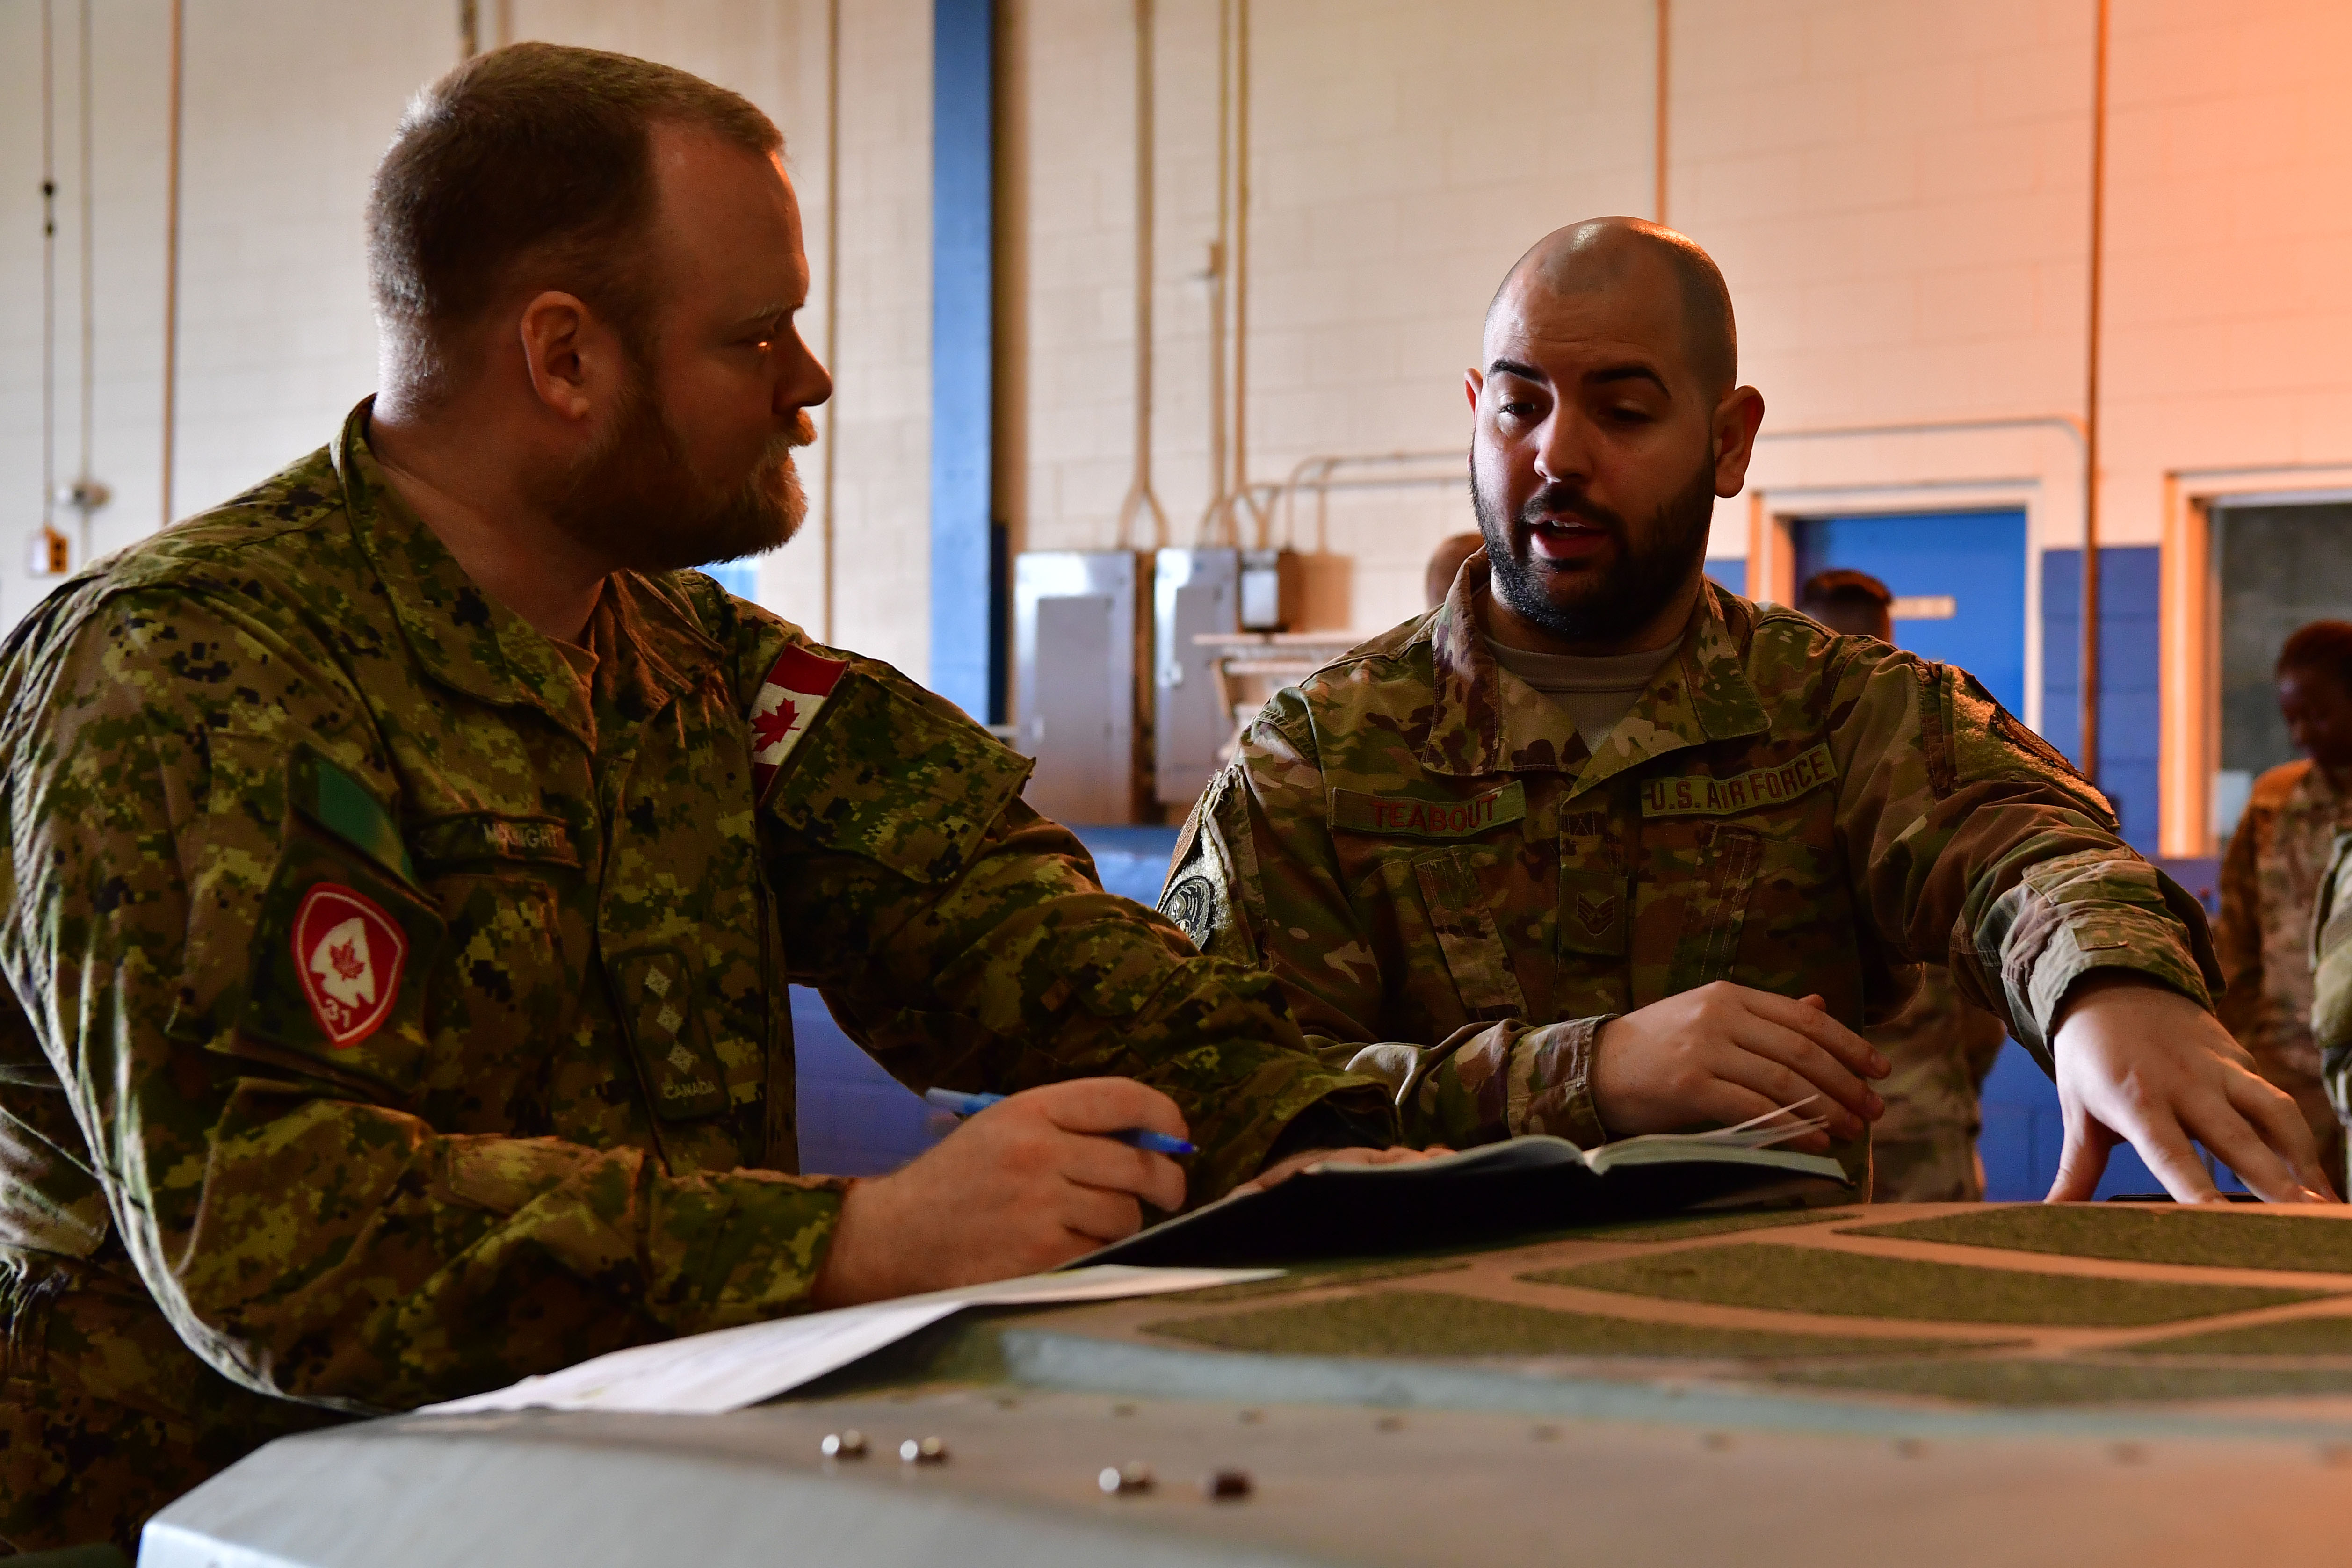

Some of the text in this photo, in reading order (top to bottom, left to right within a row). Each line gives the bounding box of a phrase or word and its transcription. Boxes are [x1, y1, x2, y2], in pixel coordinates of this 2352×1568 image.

[1650, 751, 1827, 811] U.S. AIR FORCE
[1370, 794, 1498, 832] TEABOUT
[662, 1080, 716, 1099] CANADA
